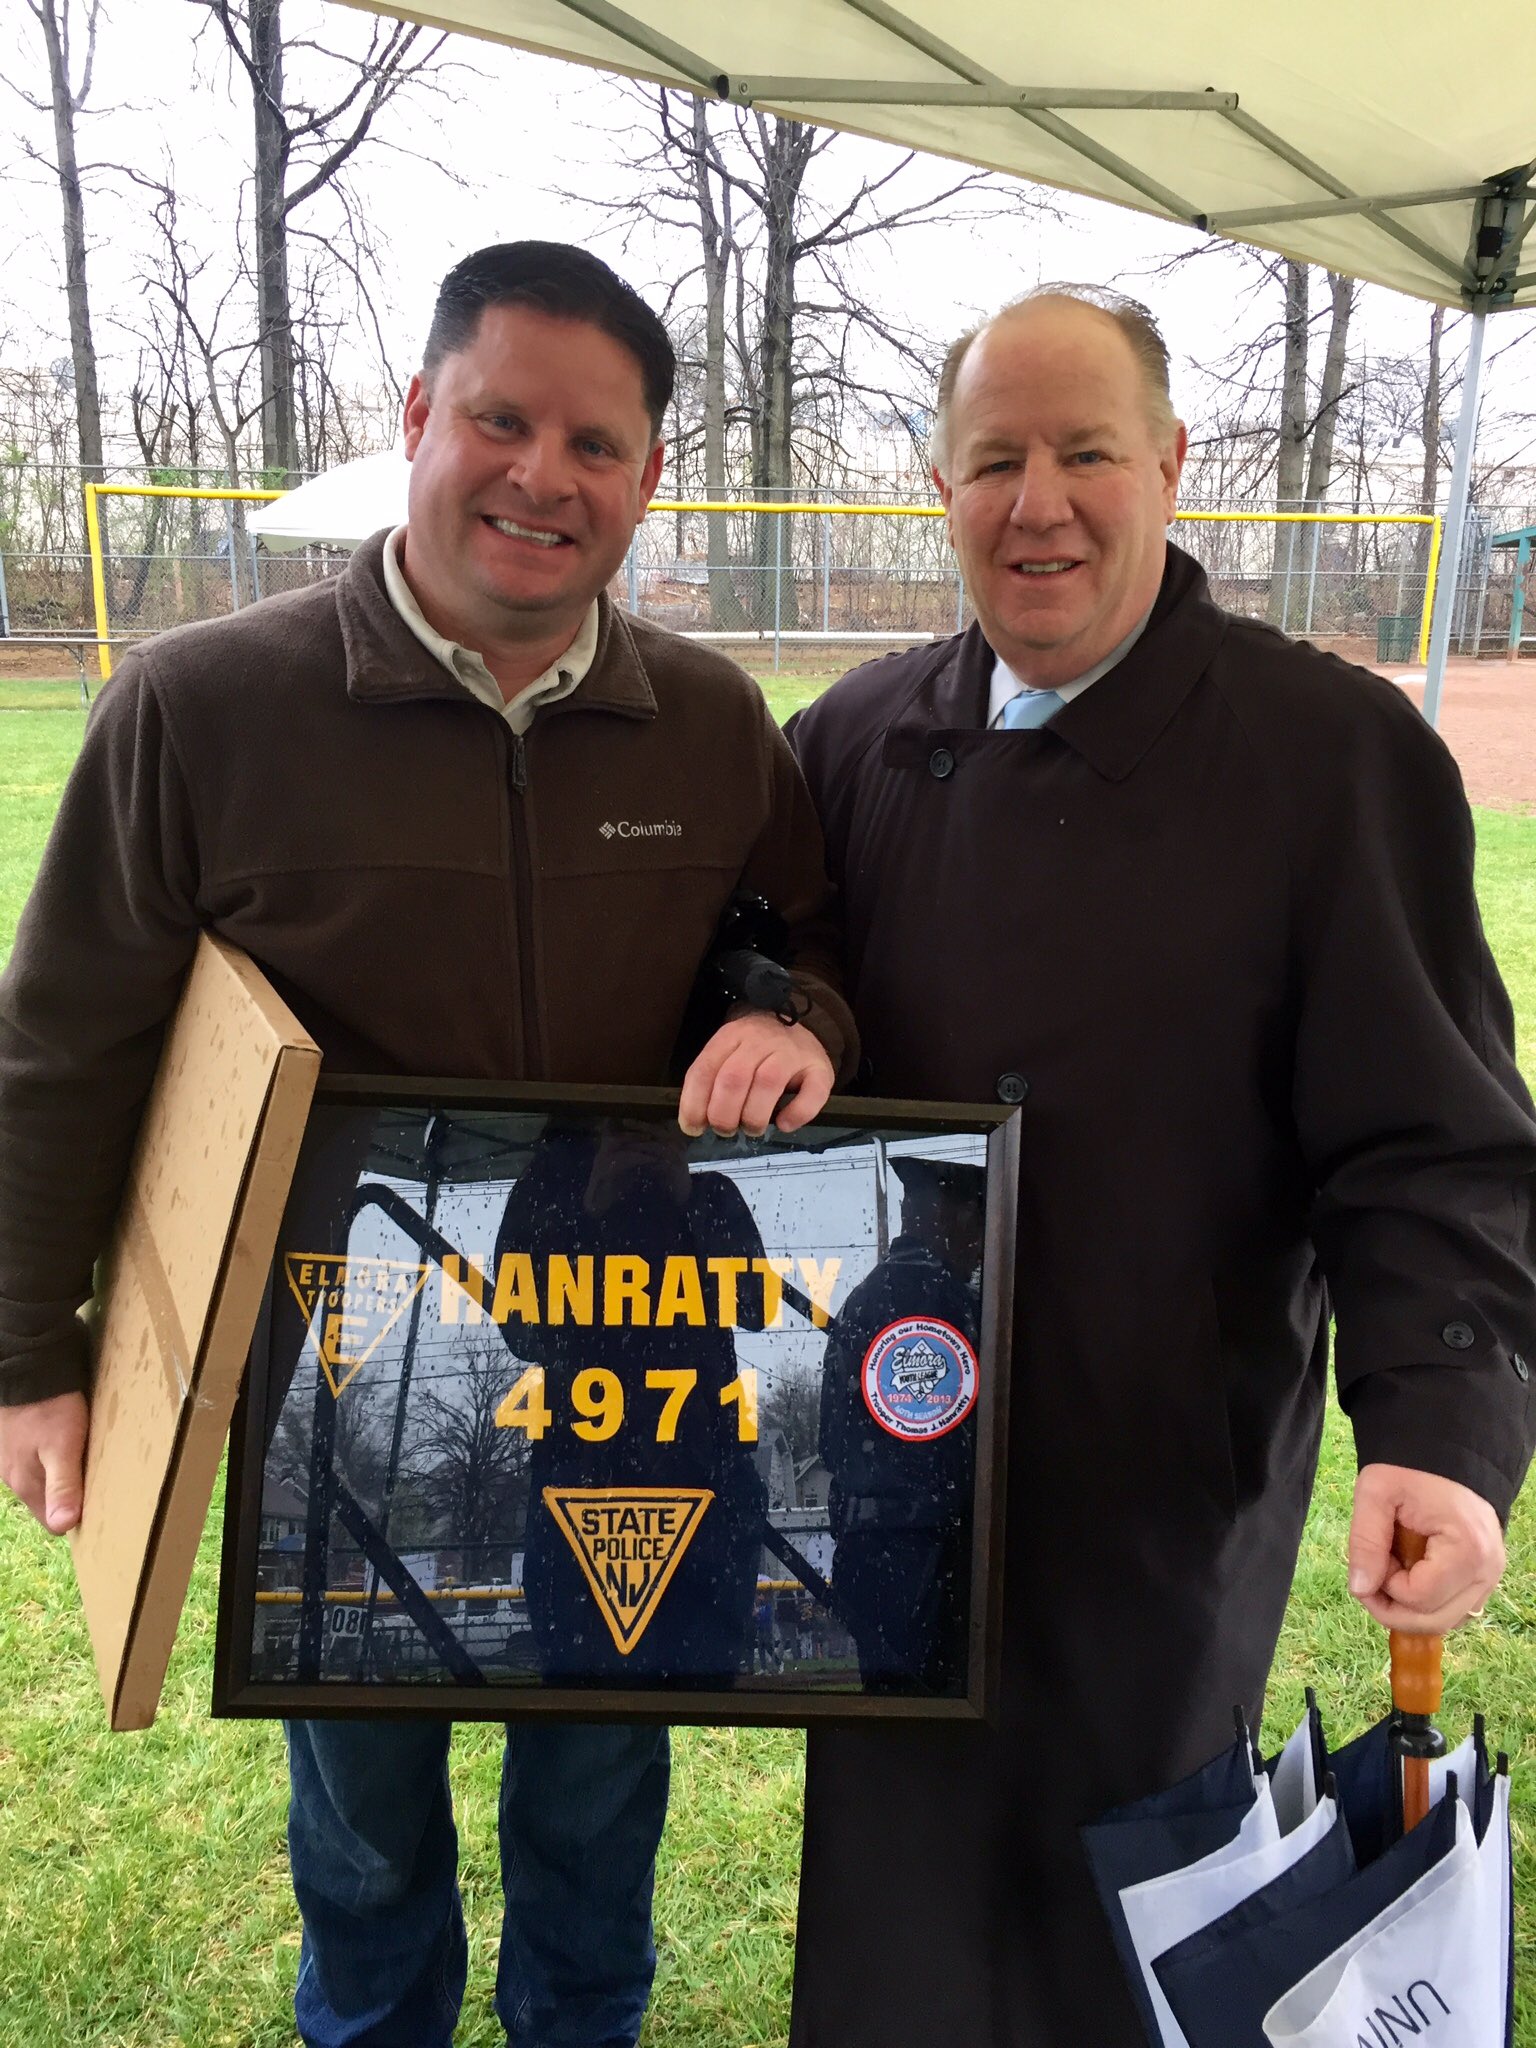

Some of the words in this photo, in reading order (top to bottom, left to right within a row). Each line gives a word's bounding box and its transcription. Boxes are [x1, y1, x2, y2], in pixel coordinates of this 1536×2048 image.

[617, 819, 682, 838] Columbia
[300, 1263, 408, 1295] ELMORA
[440, 1252, 842, 1328] HANRATTY
[869, 1333, 897, 1371] Honoring
[898, 1325, 913, 1335] our
[916, 1323, 961, 1351] Hometown
[959, 1351, 971, 1375] Hero
[495, 1367, 759, 1443] 4971
[870, 1391, 894, 1424] Trooper
[896, 1421, 928, 1434] Thomas
[938, 1394, 970, 1426] Hanratty
[581, 1508, 677, 1536] STATE
[593, 1537, 665, 1561] POLICE
[605, 1562, 651, 1608] NJ
